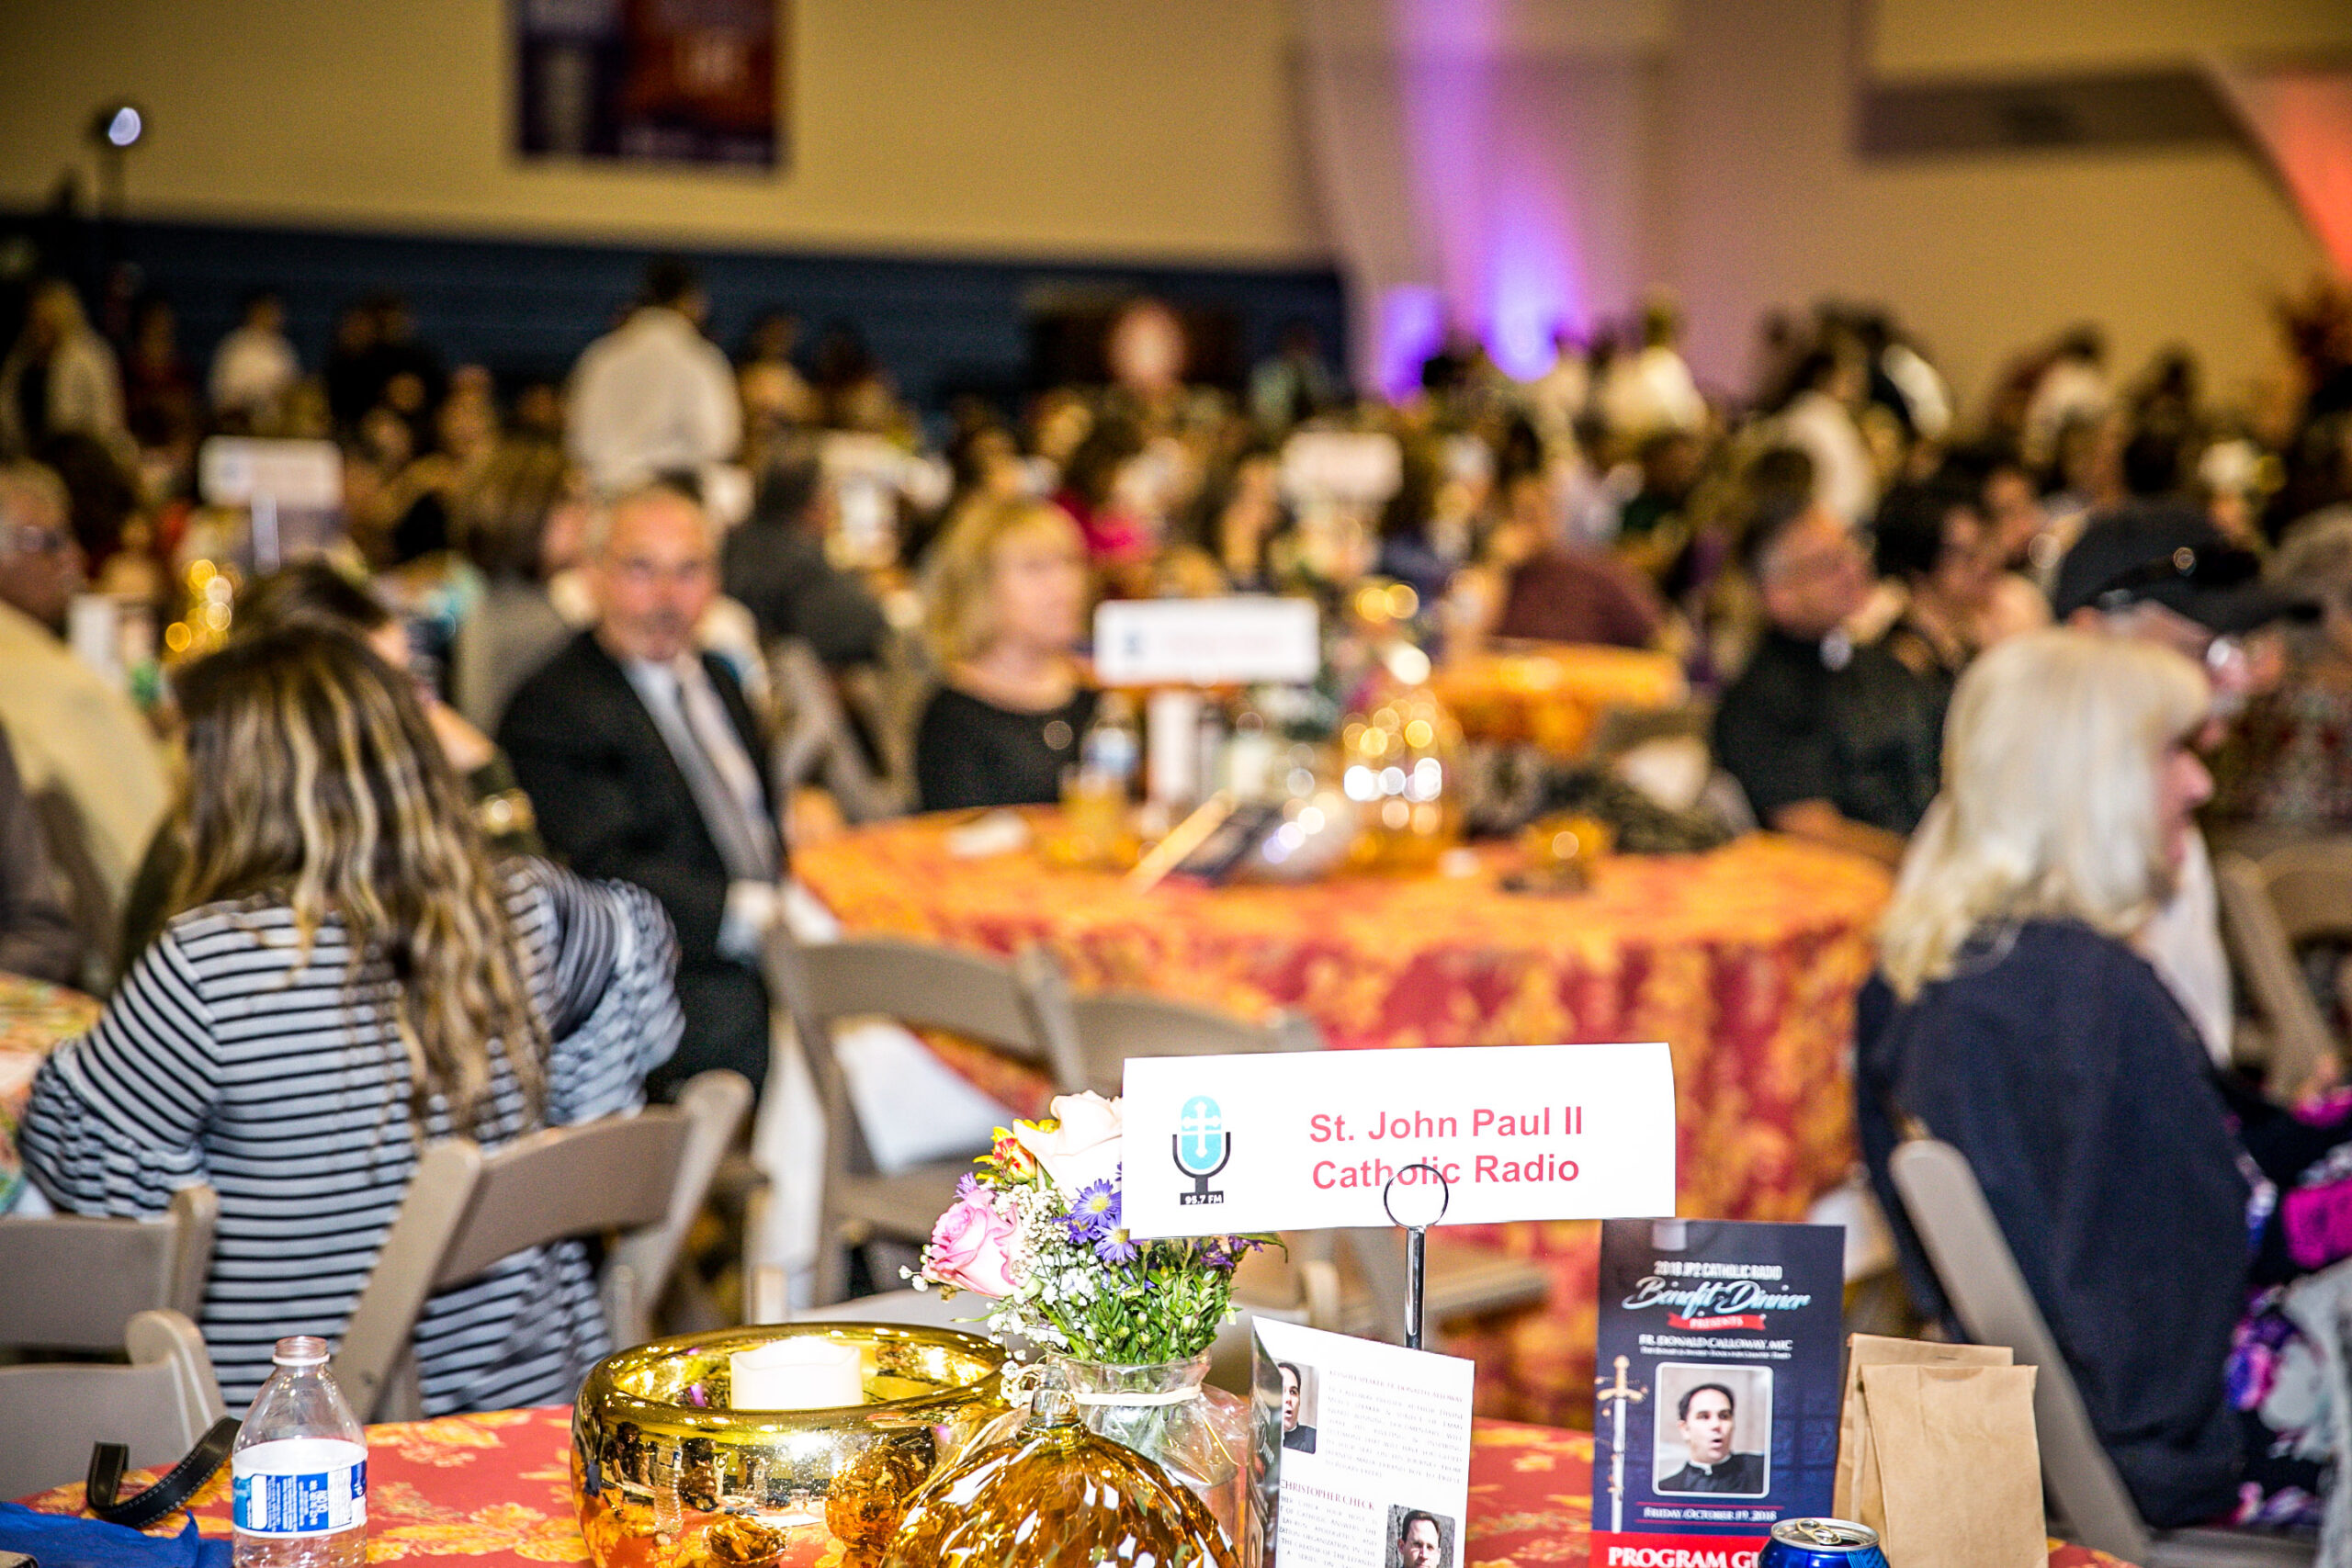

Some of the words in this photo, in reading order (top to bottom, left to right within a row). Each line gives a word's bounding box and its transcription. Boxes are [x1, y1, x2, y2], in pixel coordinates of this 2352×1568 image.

[1309, 1114, 1354, 1143] St.
[1368, 1111, 1457, 1140] John
[1473, 1107, 1550, 1136] Paul
[1566, 1106, 1581, 1135] II
[1312, 1156, 1461, 1190] Catholic
[1475, 1154, 1579, 1183] Radio
[1208, 1194, 1222, 1203] FM
[1702, 1263, 1751, 1280] CATHOLIC
[1750, 1265, 1782, 1280] RADIO
[1622, 1276, 1725, 1319] Benefit
[1714, 1280, 1812, 1314] Dinner
[1689, 1315, 1744, 1329] PRESENTS
[1657, 1335, 1707, 1348] DONALD
[1342, 1495, 1374, 1511] CHECK
[1608, 1546, 1727, 1568] PROGRAM
